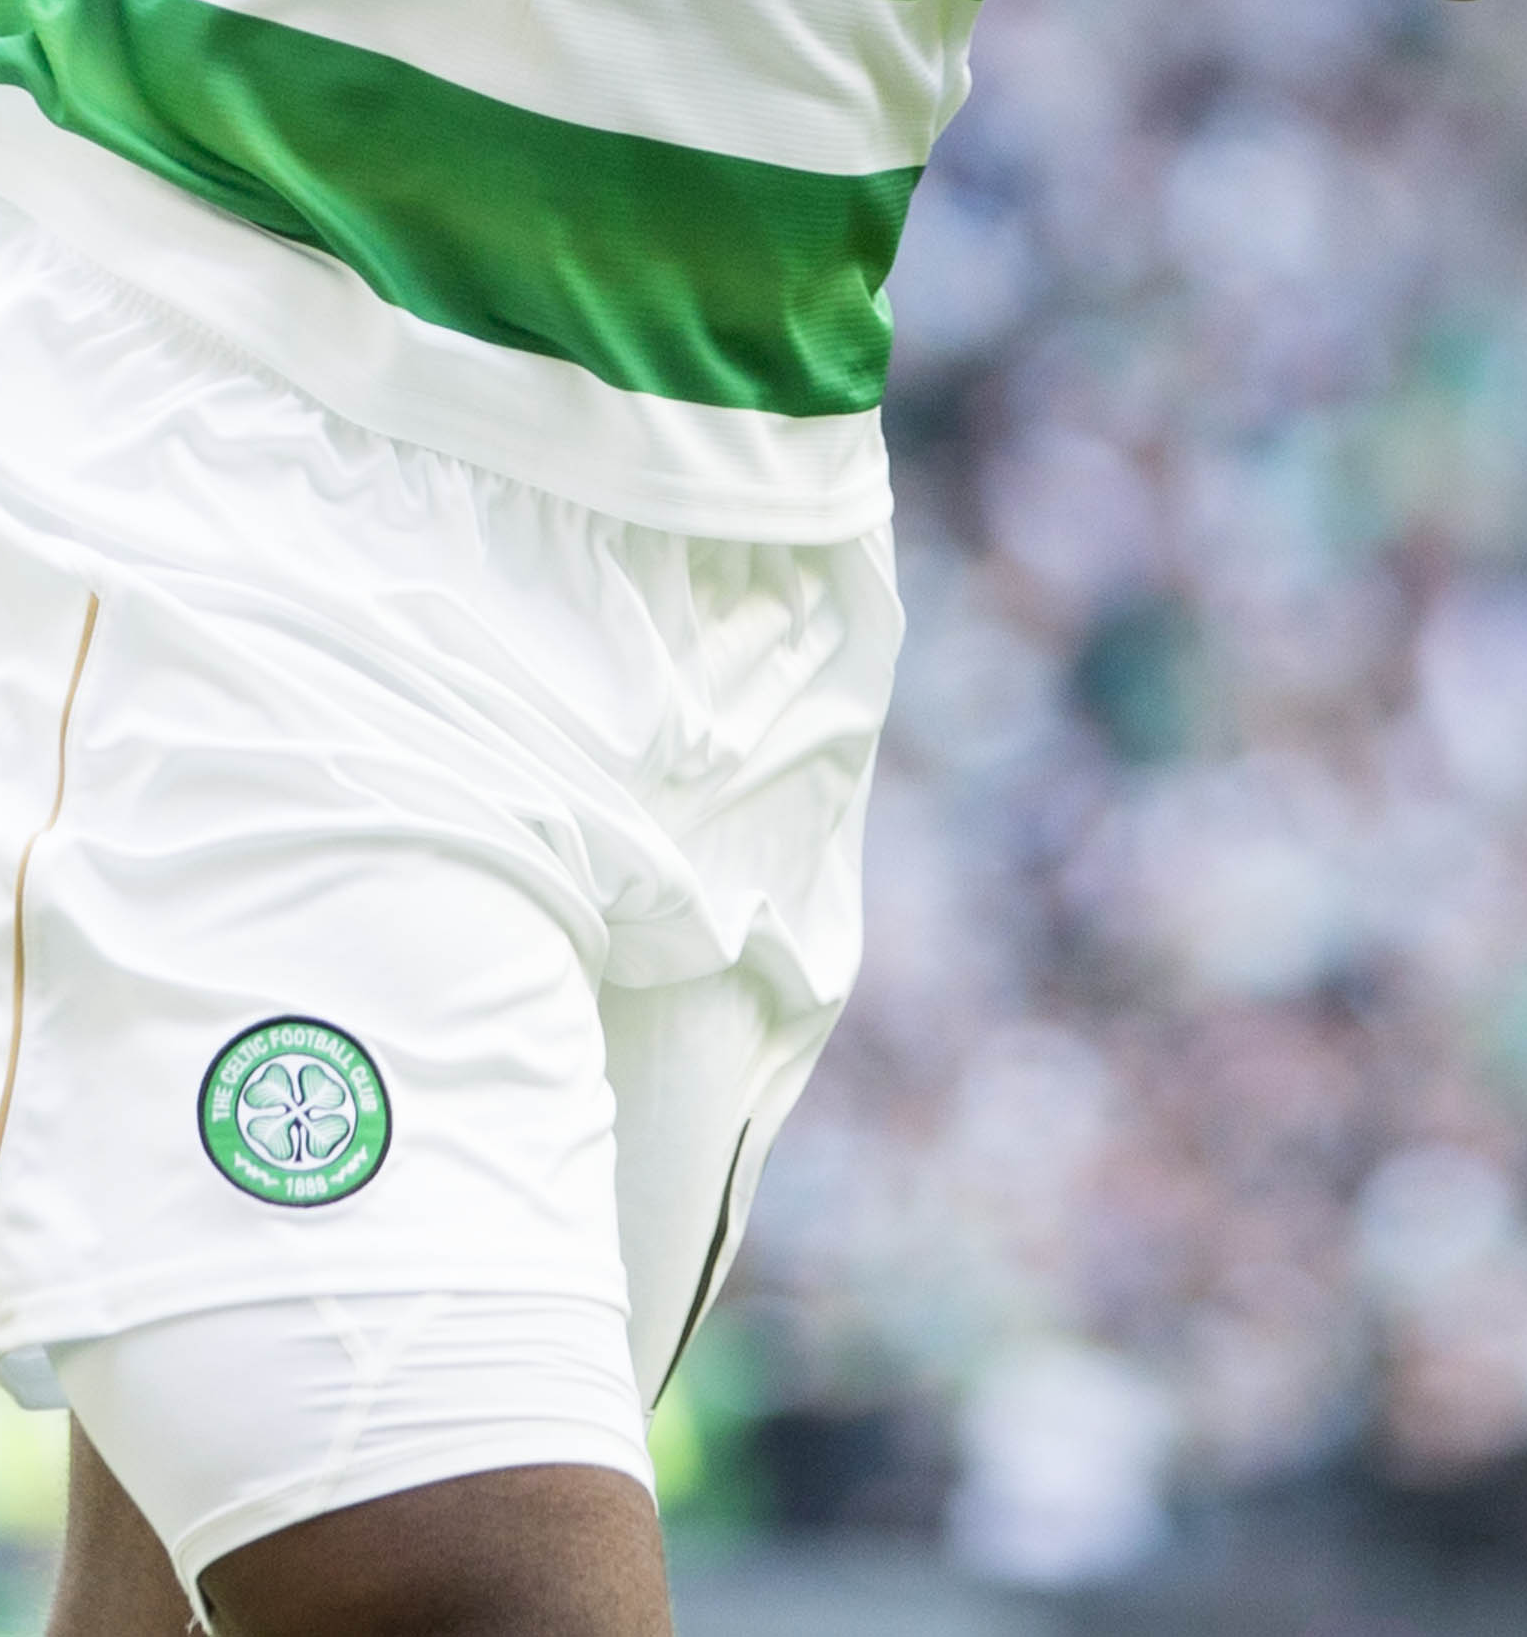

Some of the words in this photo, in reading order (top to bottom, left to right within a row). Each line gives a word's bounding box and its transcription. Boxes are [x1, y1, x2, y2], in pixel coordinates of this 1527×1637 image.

[220, 1036, 269, 1084] CELTIC
[269, 1029, 355, 1070] FOOTBALL
[212, 1085, 233, 1123] THE
[350, 1066, 378, 1112] CLUB
[285, 1175, 329, 1197] 1888
